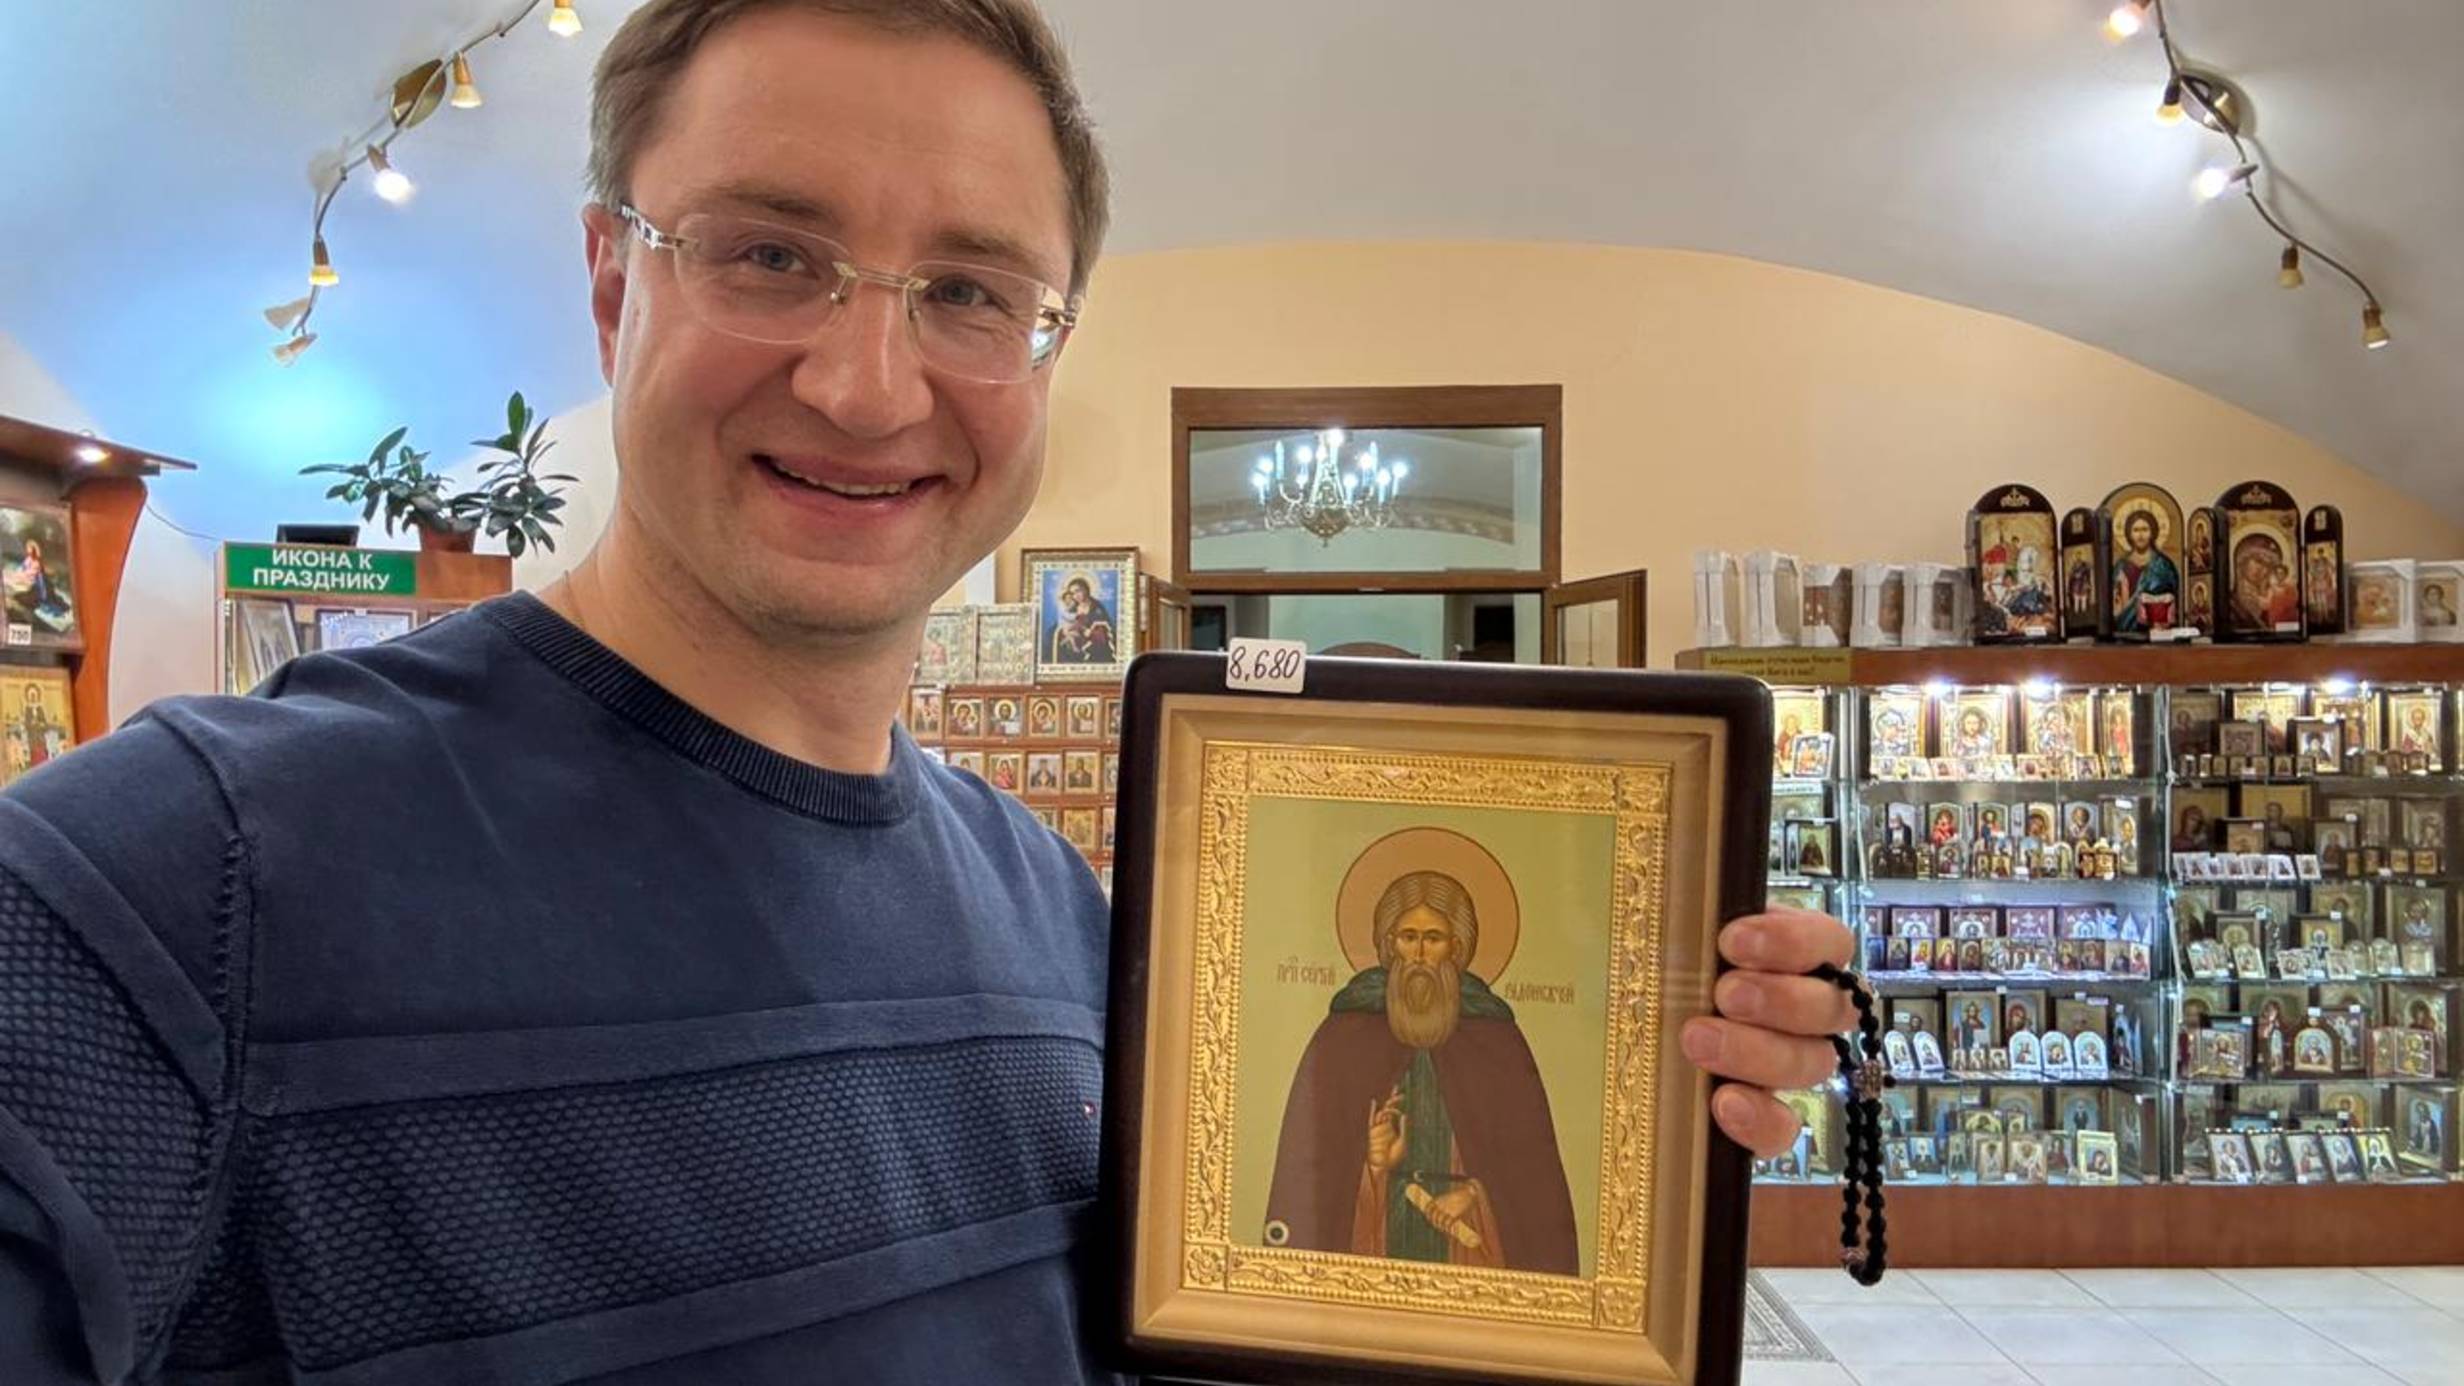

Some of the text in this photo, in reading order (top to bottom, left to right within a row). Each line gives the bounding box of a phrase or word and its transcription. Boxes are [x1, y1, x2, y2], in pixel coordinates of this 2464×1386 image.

[272, 549, 373, 570] ИКОНА К
[253, 568, 390, 591] ПРАЗДНИКУ
[1230, 646, 1300, 682] 8,680
